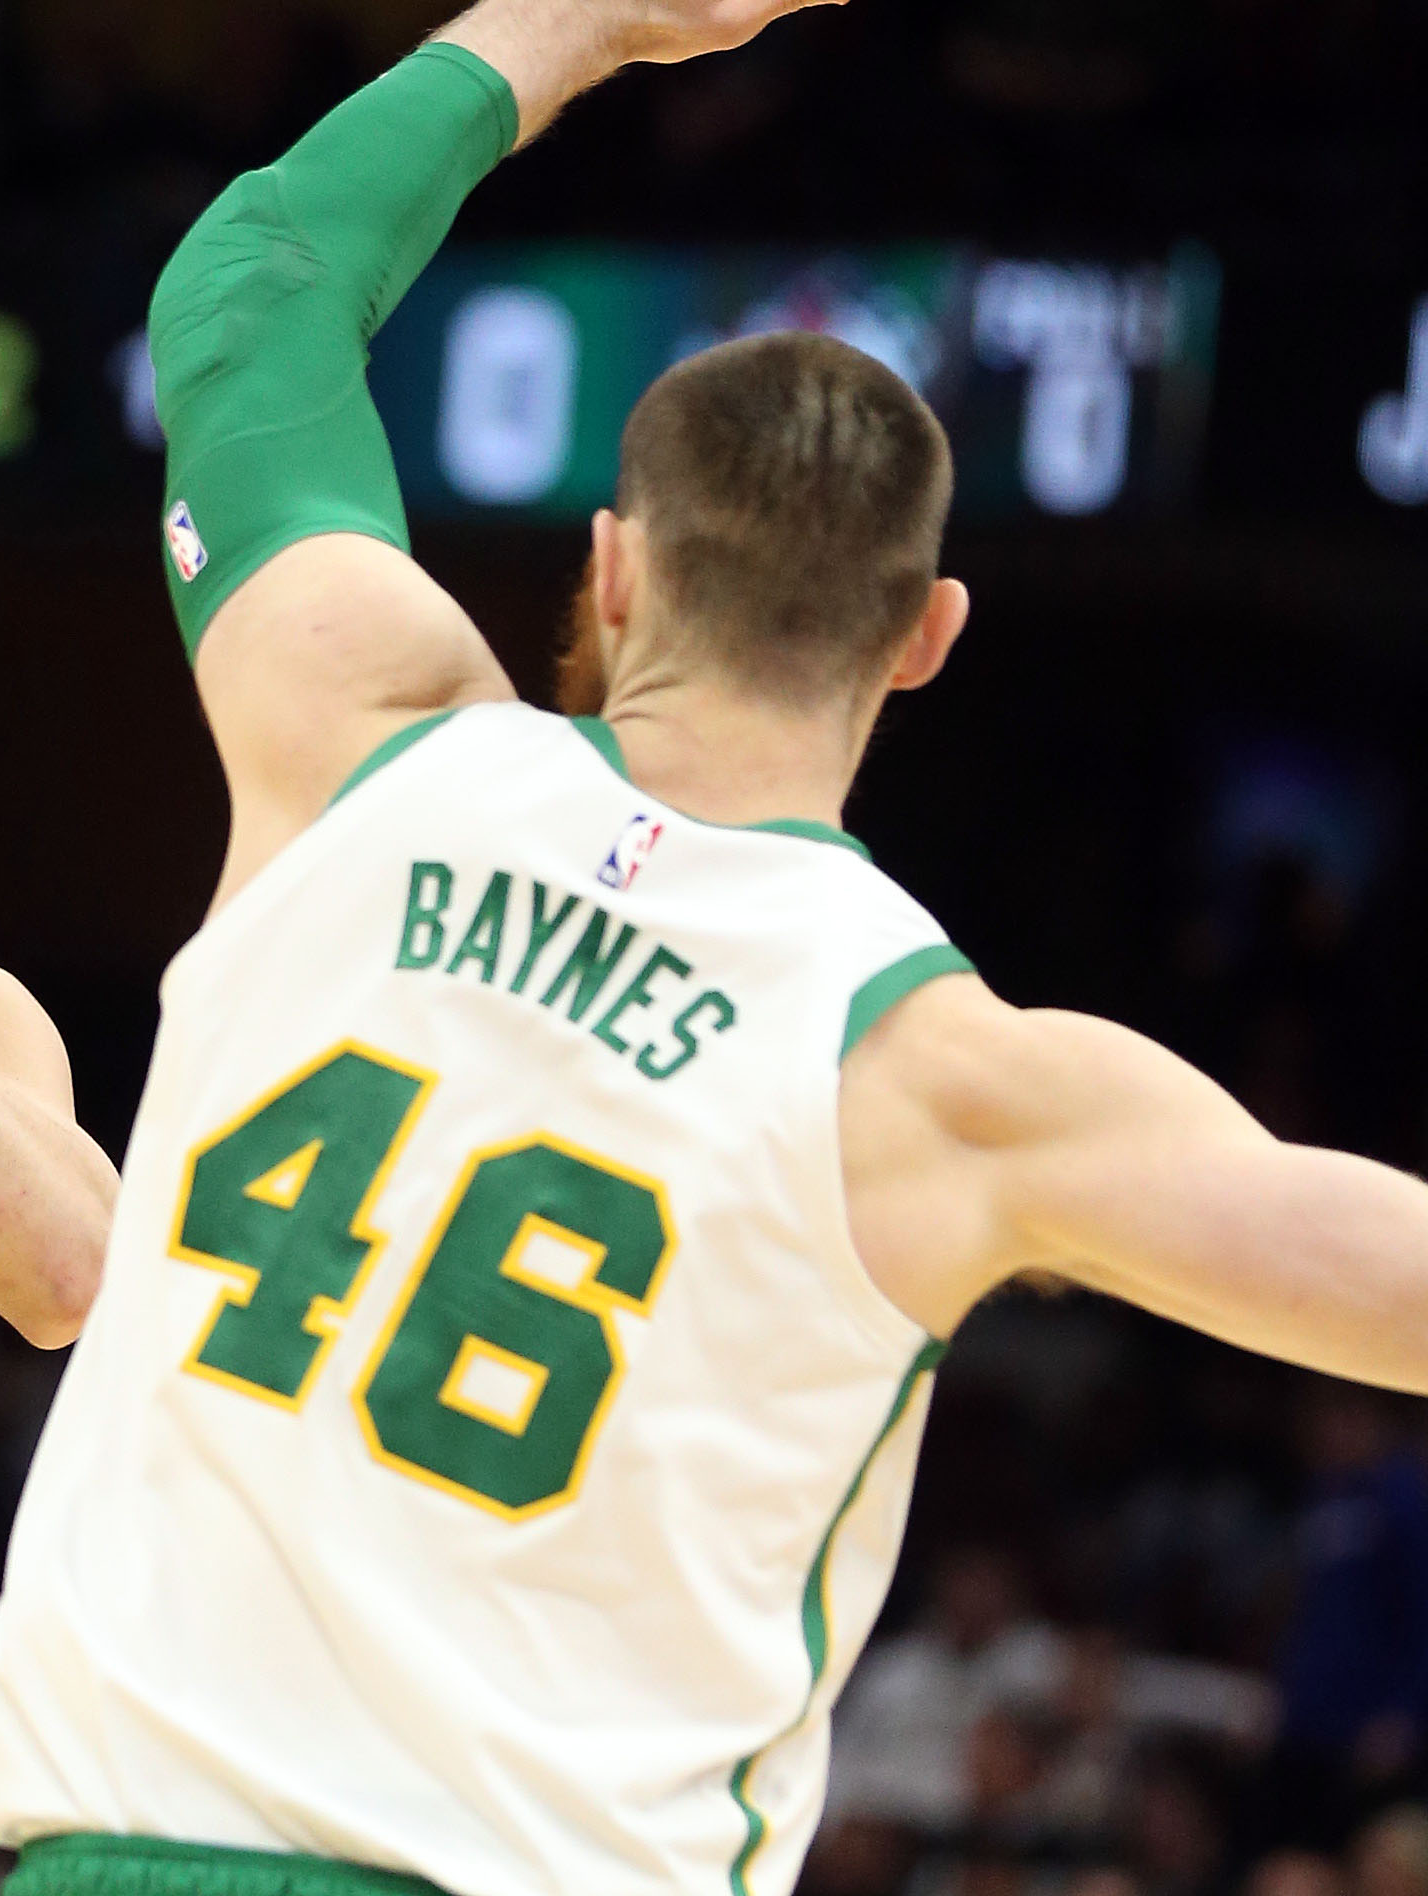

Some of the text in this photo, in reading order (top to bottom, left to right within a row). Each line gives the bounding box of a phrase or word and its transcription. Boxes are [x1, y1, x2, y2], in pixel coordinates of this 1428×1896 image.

[440, 288, 578, 504] 0
[395, 860, 738, 1081] BAYNES
[167, 1037, 680, 1525] 46
